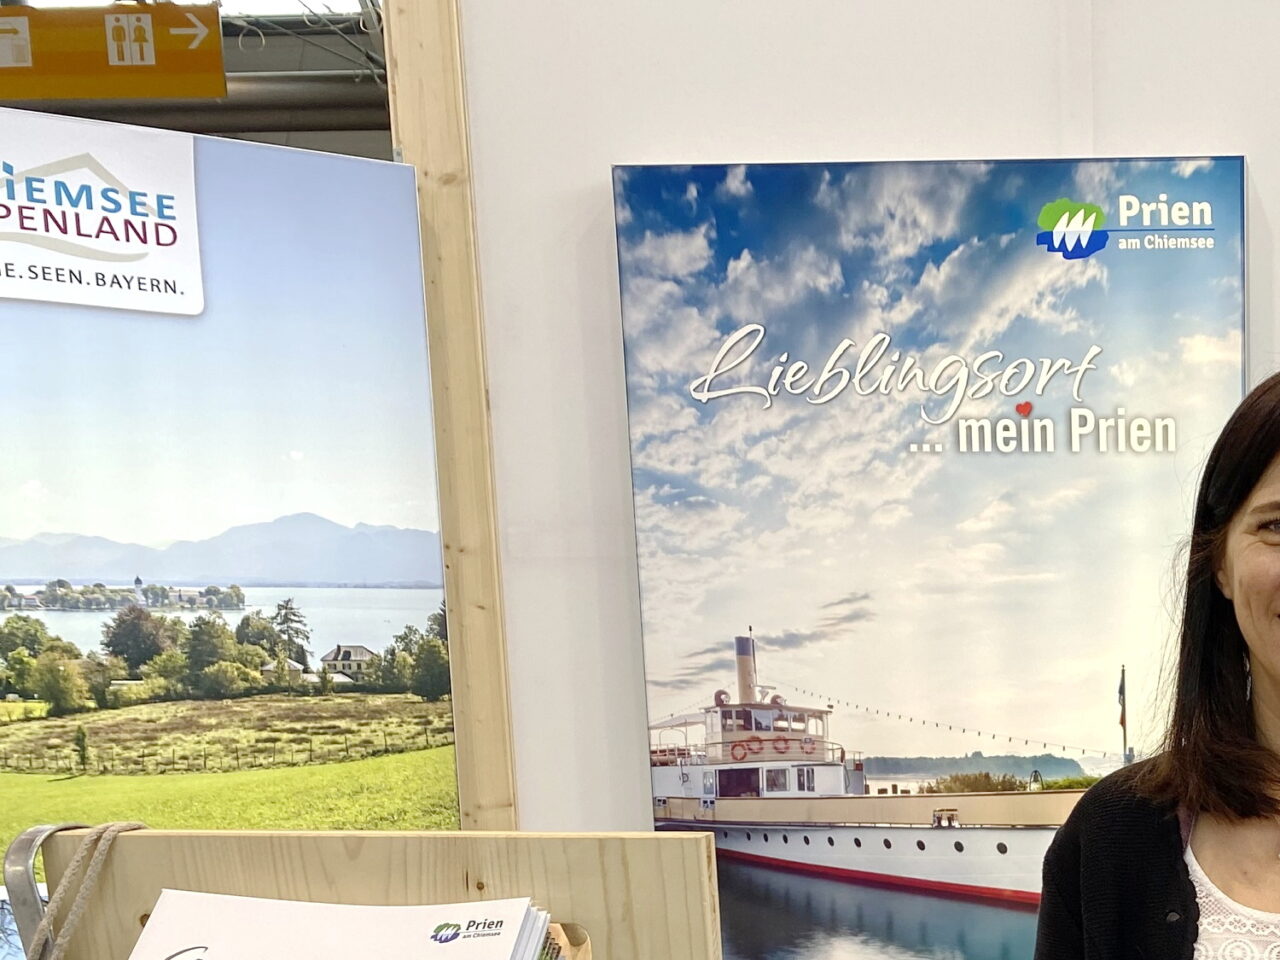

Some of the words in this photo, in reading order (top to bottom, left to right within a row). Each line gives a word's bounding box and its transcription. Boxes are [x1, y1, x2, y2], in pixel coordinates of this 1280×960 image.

[1117, 194, 1213, 226] Prien
[1117, 238, 1142, 250] am
[1144, 233, 1215, 250] Chiemsee
[688, 322, 1103, 425] Lieblingsort
[958, 408, 1056, 454] mein
[1070, 408, 1177, 453] Prien
[465, 918, 504, 931] Prien
